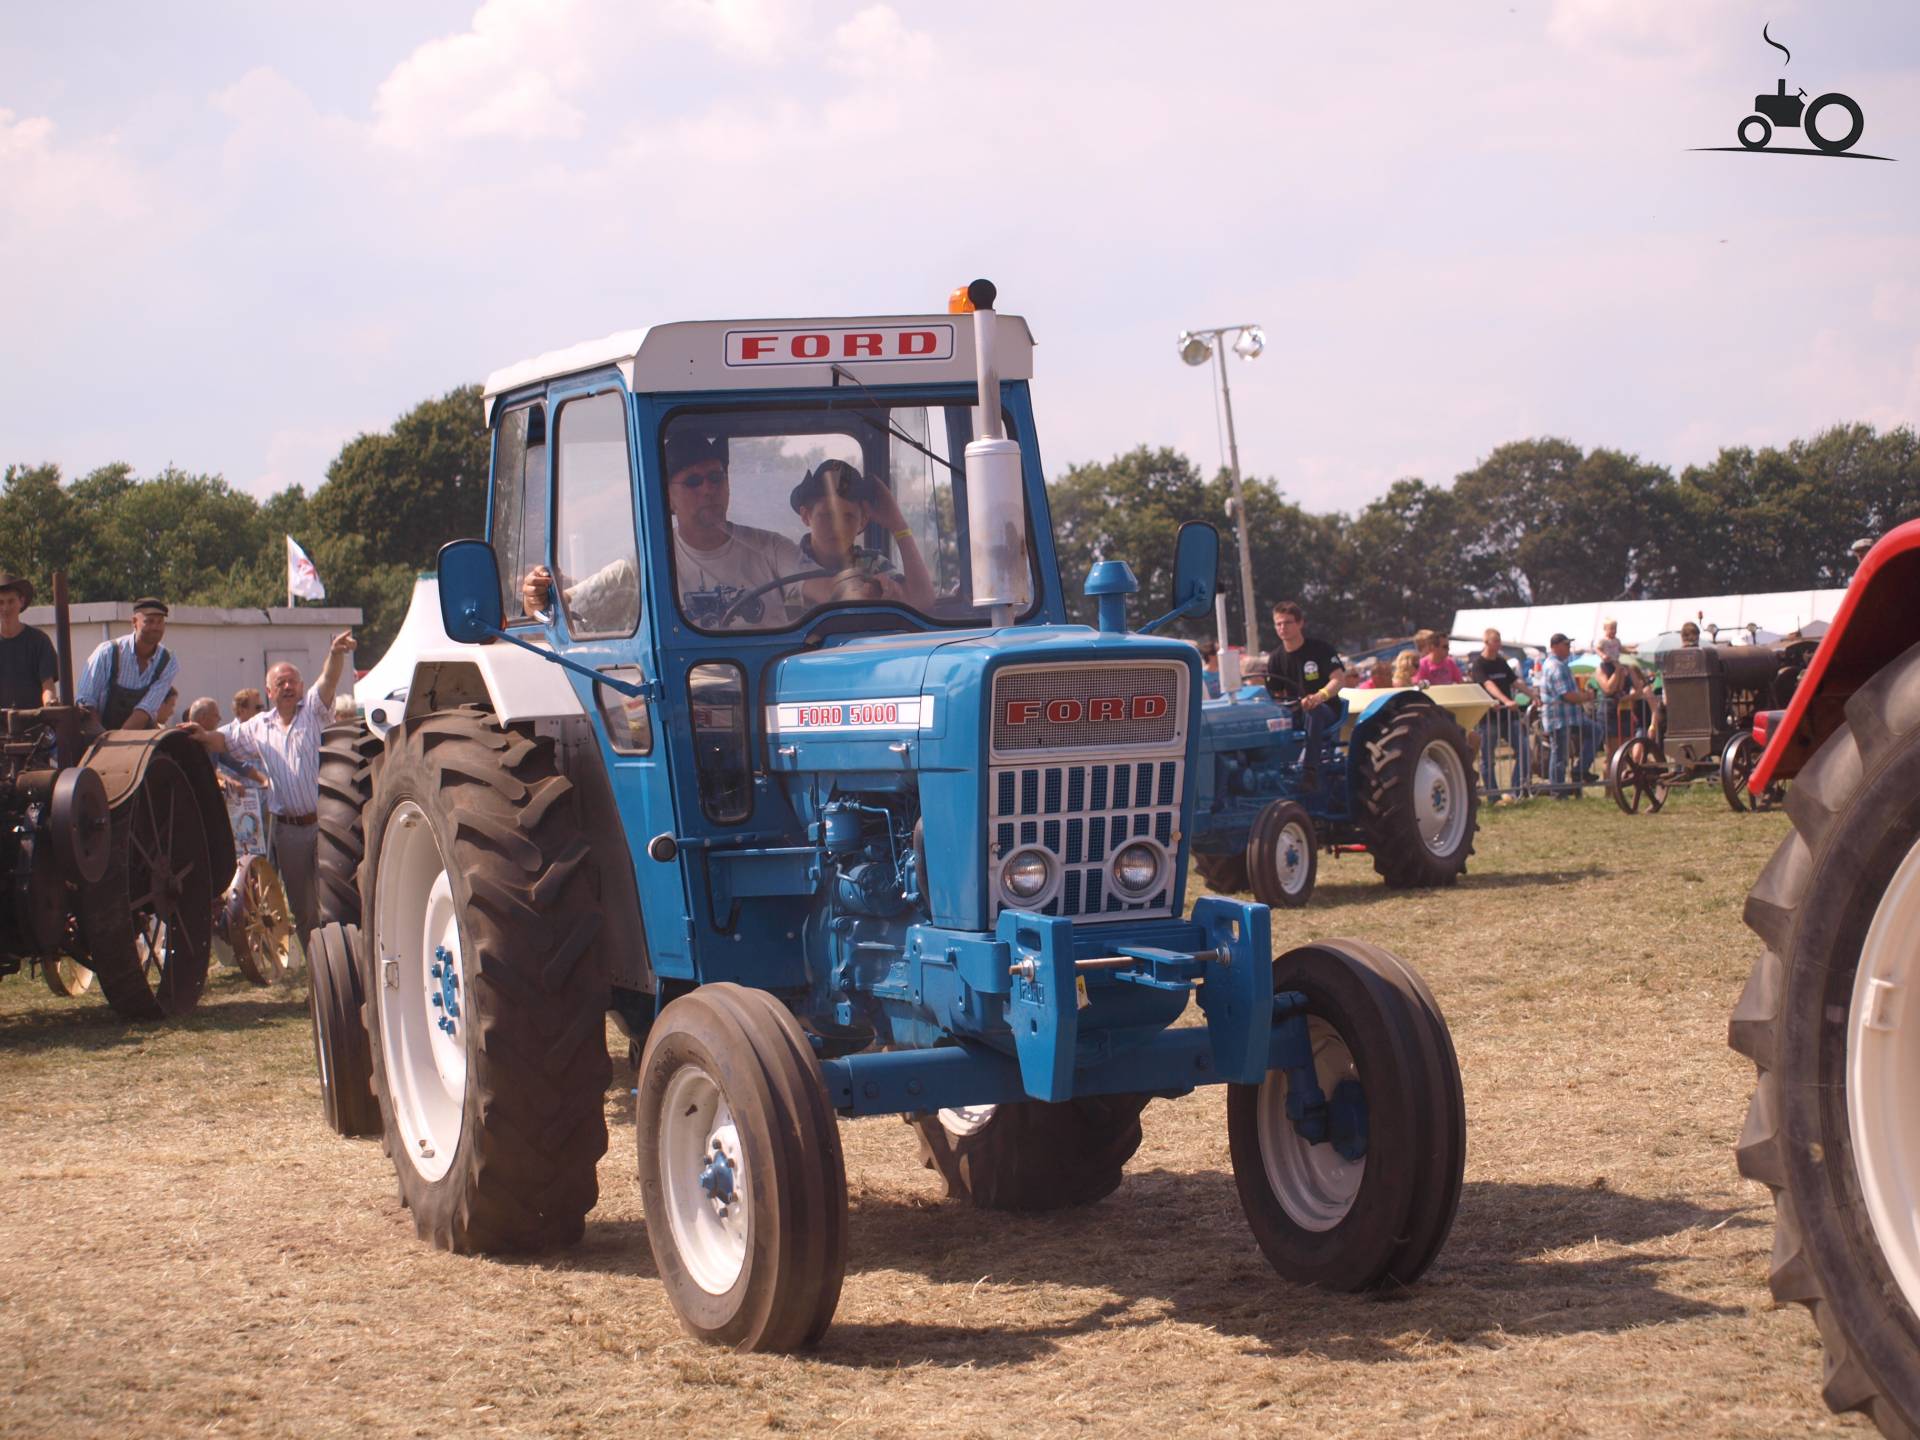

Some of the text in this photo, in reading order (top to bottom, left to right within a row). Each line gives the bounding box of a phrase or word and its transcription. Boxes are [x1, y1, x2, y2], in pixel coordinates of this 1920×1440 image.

[741, 331, 937, 360] FORD
[799, 703, 898, 726] FORD 5000
[1006, 695, 1168, 725] FORD
